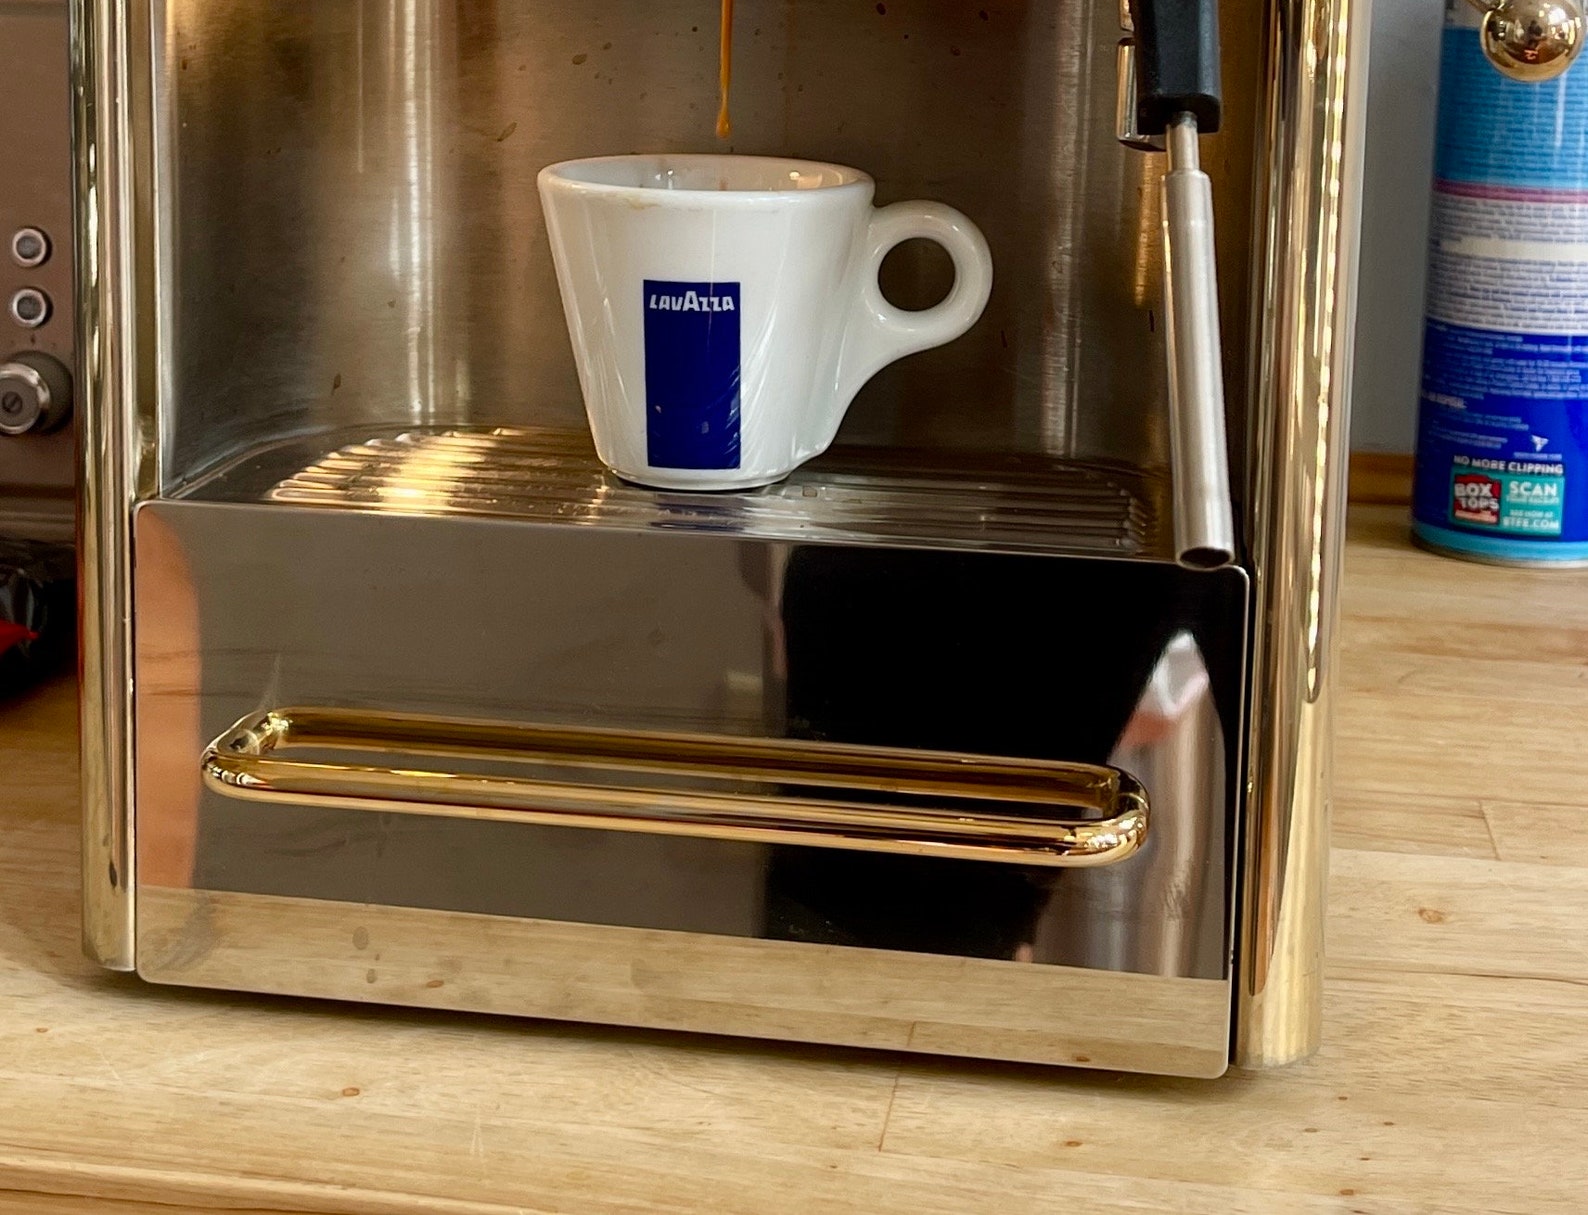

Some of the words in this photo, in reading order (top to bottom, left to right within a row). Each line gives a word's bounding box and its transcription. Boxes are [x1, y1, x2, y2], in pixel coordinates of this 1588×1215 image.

[650, 291, 734, 311] LAVAZZA
[1453, 455, 1470, 465] NO
[1472, 458, 1506, 471] MORE
[1508, 462, 1563, 474] CLIPPING
[1454, 482, 1493, 497] BOX
[1509, 480, 1557, 496] SCAN
[1459, 496, 1500, 511] TOPS
